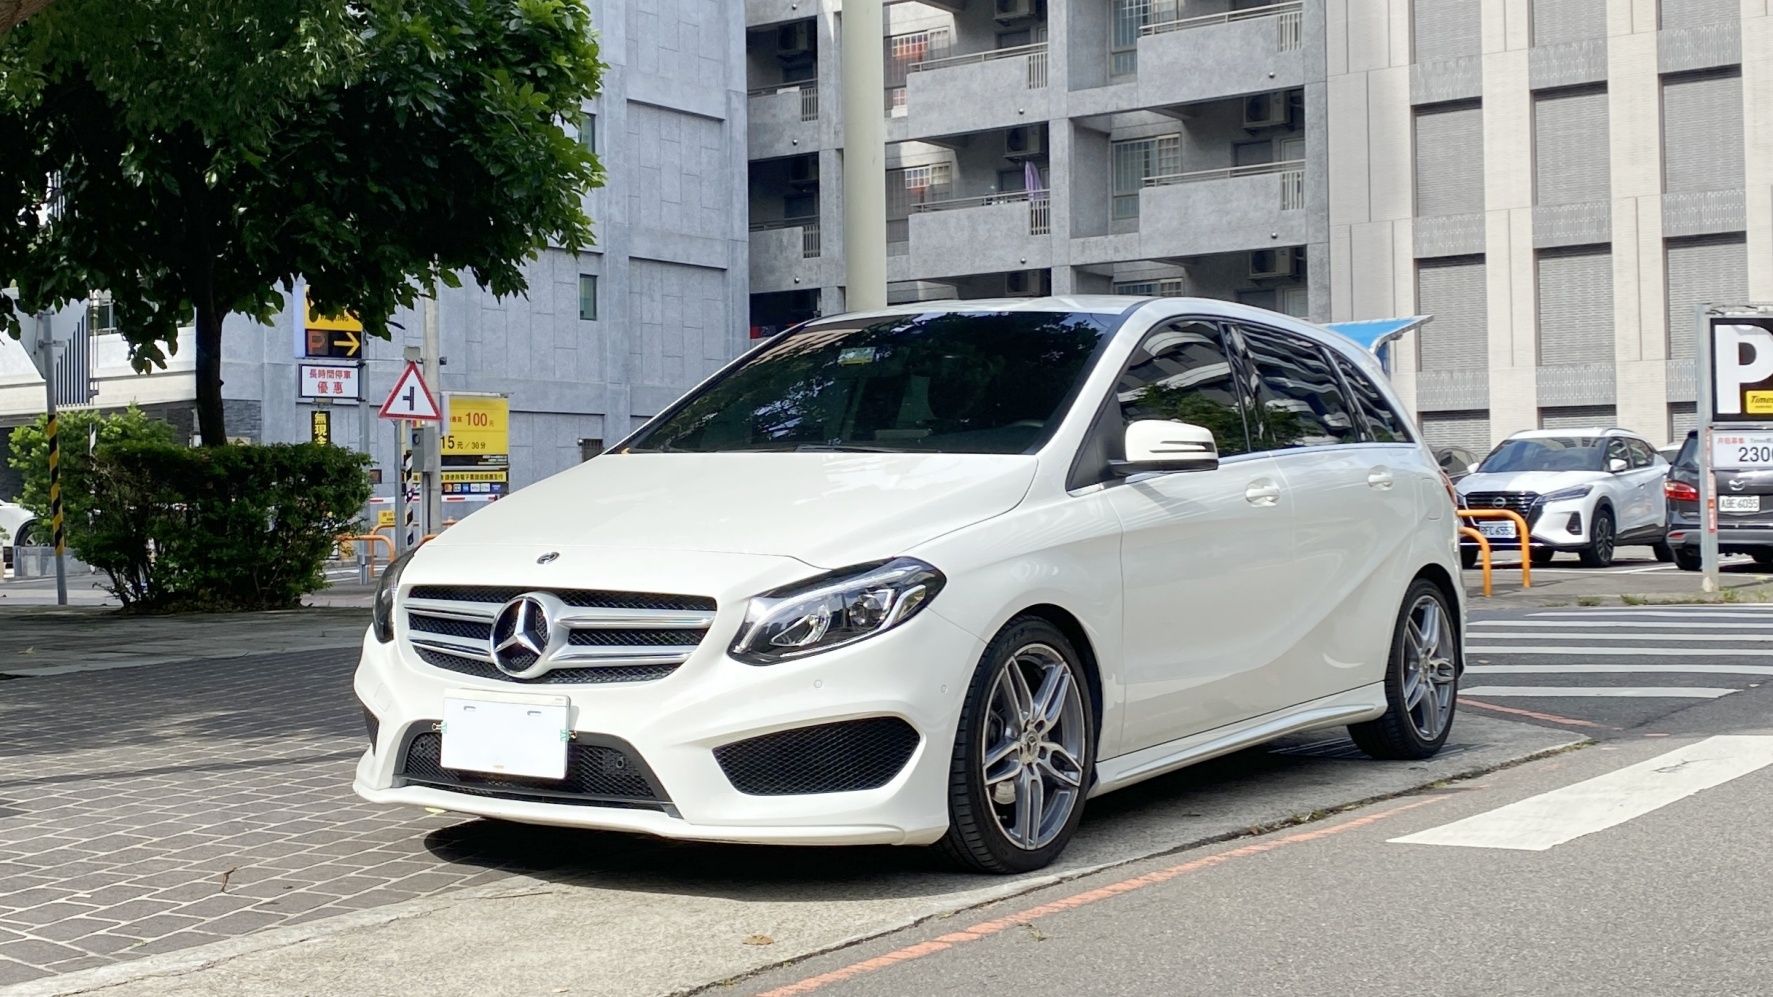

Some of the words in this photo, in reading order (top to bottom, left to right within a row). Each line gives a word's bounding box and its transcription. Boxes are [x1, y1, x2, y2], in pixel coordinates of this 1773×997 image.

[309, 369, 351, 379] 長時間停車
[1715, 325, 1773, 414] P
[318, 381, 343, 394] 優惠
[1738, 446, 1773, 462] 230
